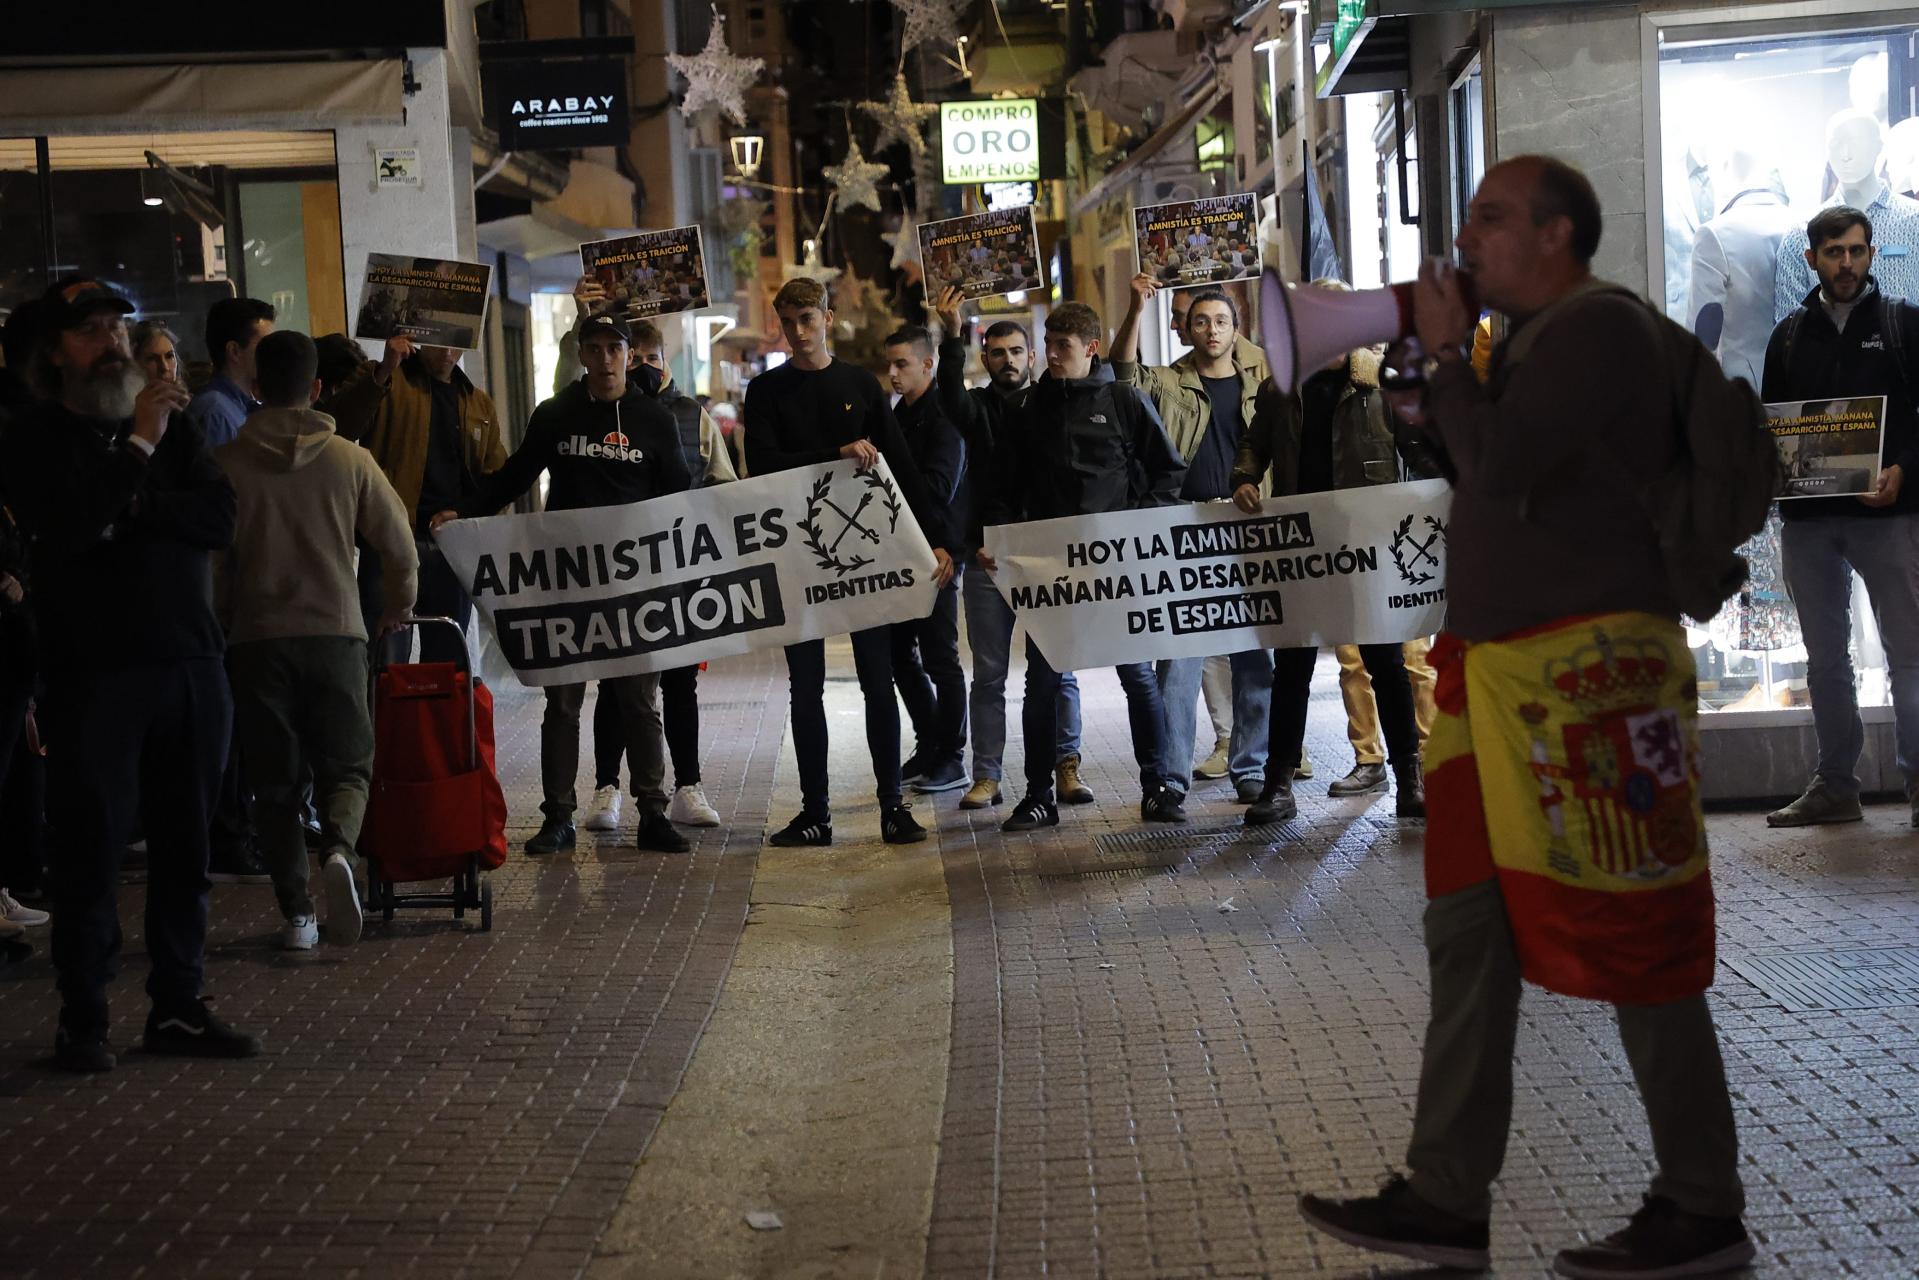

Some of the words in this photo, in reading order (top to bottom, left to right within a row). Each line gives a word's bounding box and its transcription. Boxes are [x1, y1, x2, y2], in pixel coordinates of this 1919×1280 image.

[511, 96, 613, 114] ARABAY
[948, 105, 1032, 122] COMPRO
[520, 118, 542, 128] coffee
[572, 115, 591, 125] since
[952, 129, 1031, 155] ORO
[1190, 216, 1202, 225] ES
[1203, 211, 1244, 224] TRAICIÓN
[971, 231, 982, 240] ES
[983, 223, 1022, 237] TRAICIÓN
[636, 251, 648, 259] ES
[648, 243, 689, 257] TRAICIÓN
[375, 266, 392, 275] HOY
[369, 274, 379, 282] LA
[439, 281, 449, 289] DE
[1830, 423, 1841, 431] DE
[557, 434, 643, 464] ellesse
[1067, 537, 1126, 568] HOY
[1134, 533, 1169, 561] LA
[1180, 516, 1312, 555] AMNISTÍA,
[472, 517, 722, 596] AMNISTÍA
[733, 508, 788, 556] ES
[804, 568, 915, 605] IDENTITAS
[1010, 575, 1135, 611] MAÑANA
[1140, 570, 1175, 596] LA
[1179, 544, 1378, 592] DESAPARICIÓN
[1388, 588, 1445, 609] IDENTIT
[509, 578, 766, 660] TRAICIÓN
[1127, 607, 1164, 635] DE
[1175, 594, 1279, 630] ESPAÑA
